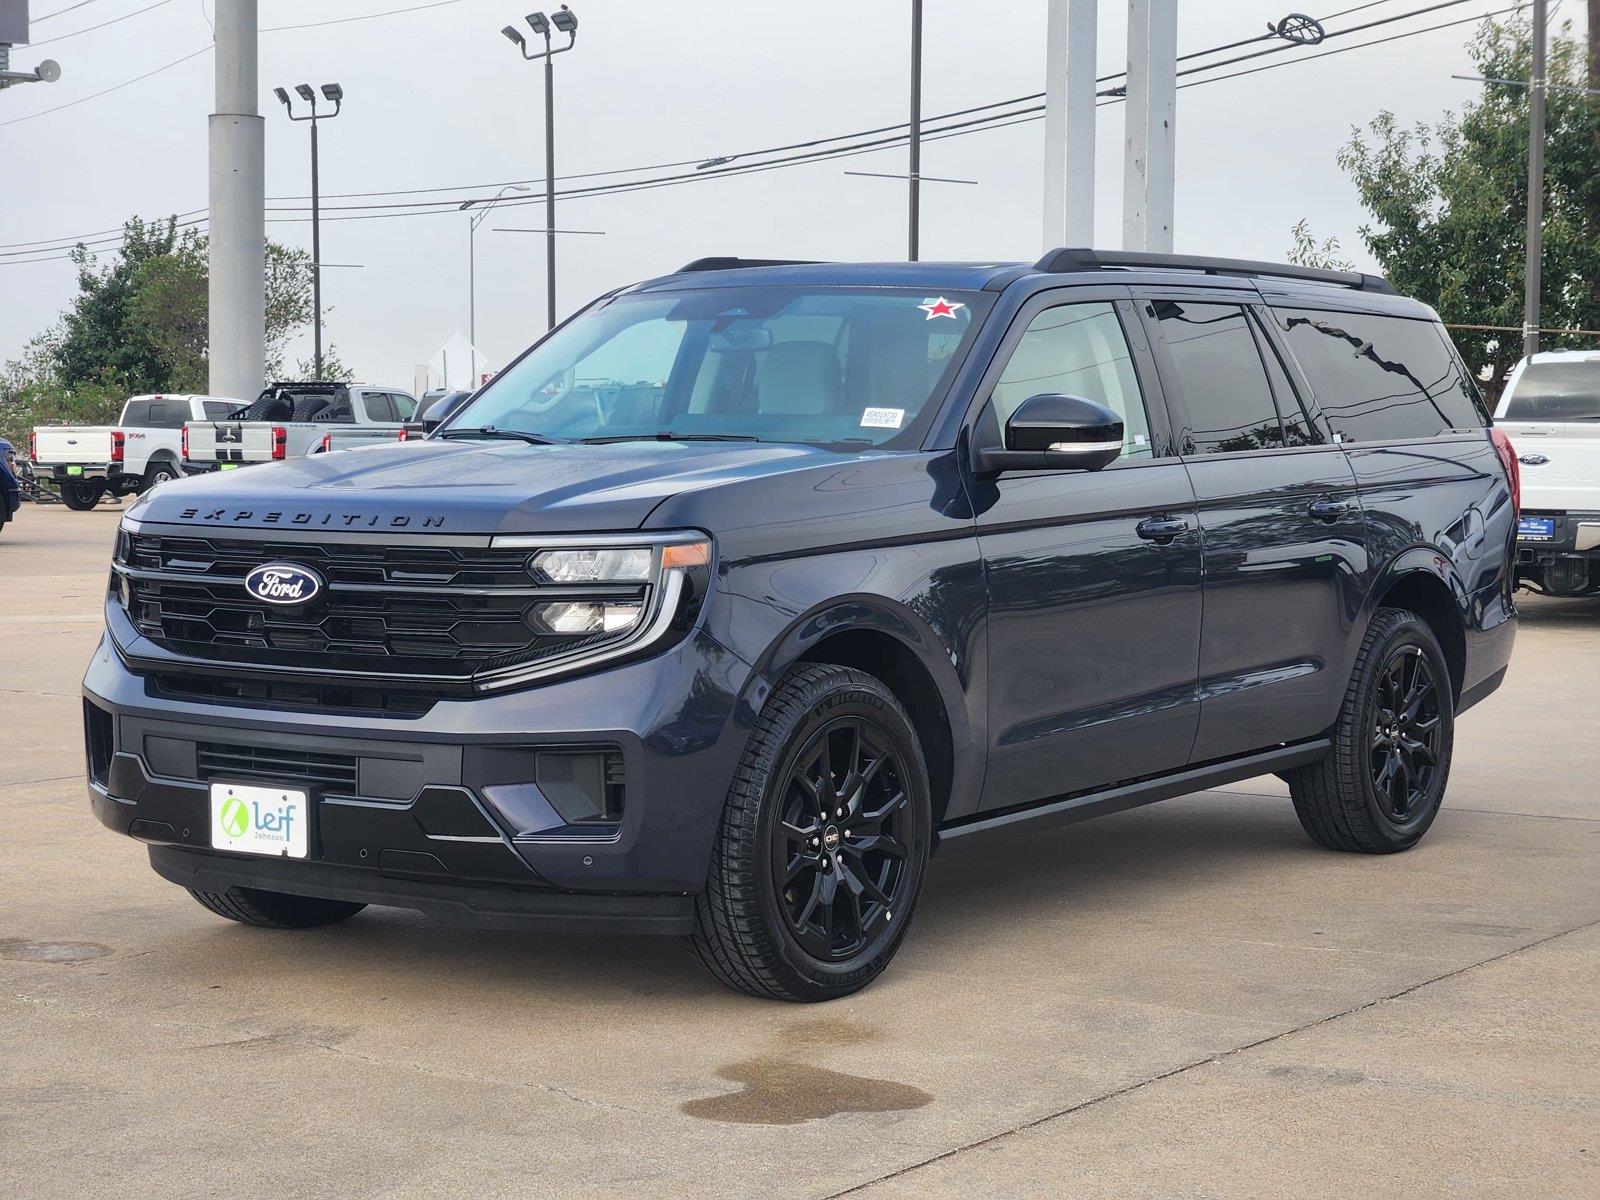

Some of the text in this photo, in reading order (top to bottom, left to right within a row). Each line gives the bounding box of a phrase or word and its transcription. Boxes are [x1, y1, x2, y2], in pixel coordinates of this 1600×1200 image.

[1523, 455, 1544, 464] Ford
[179, 508, 445, 528] EXPEDITION
[258, 571, 303, 598] Ford
[831, 692, 887, 710] MICHELIN
[254, 832, 284, 842] Johnson
